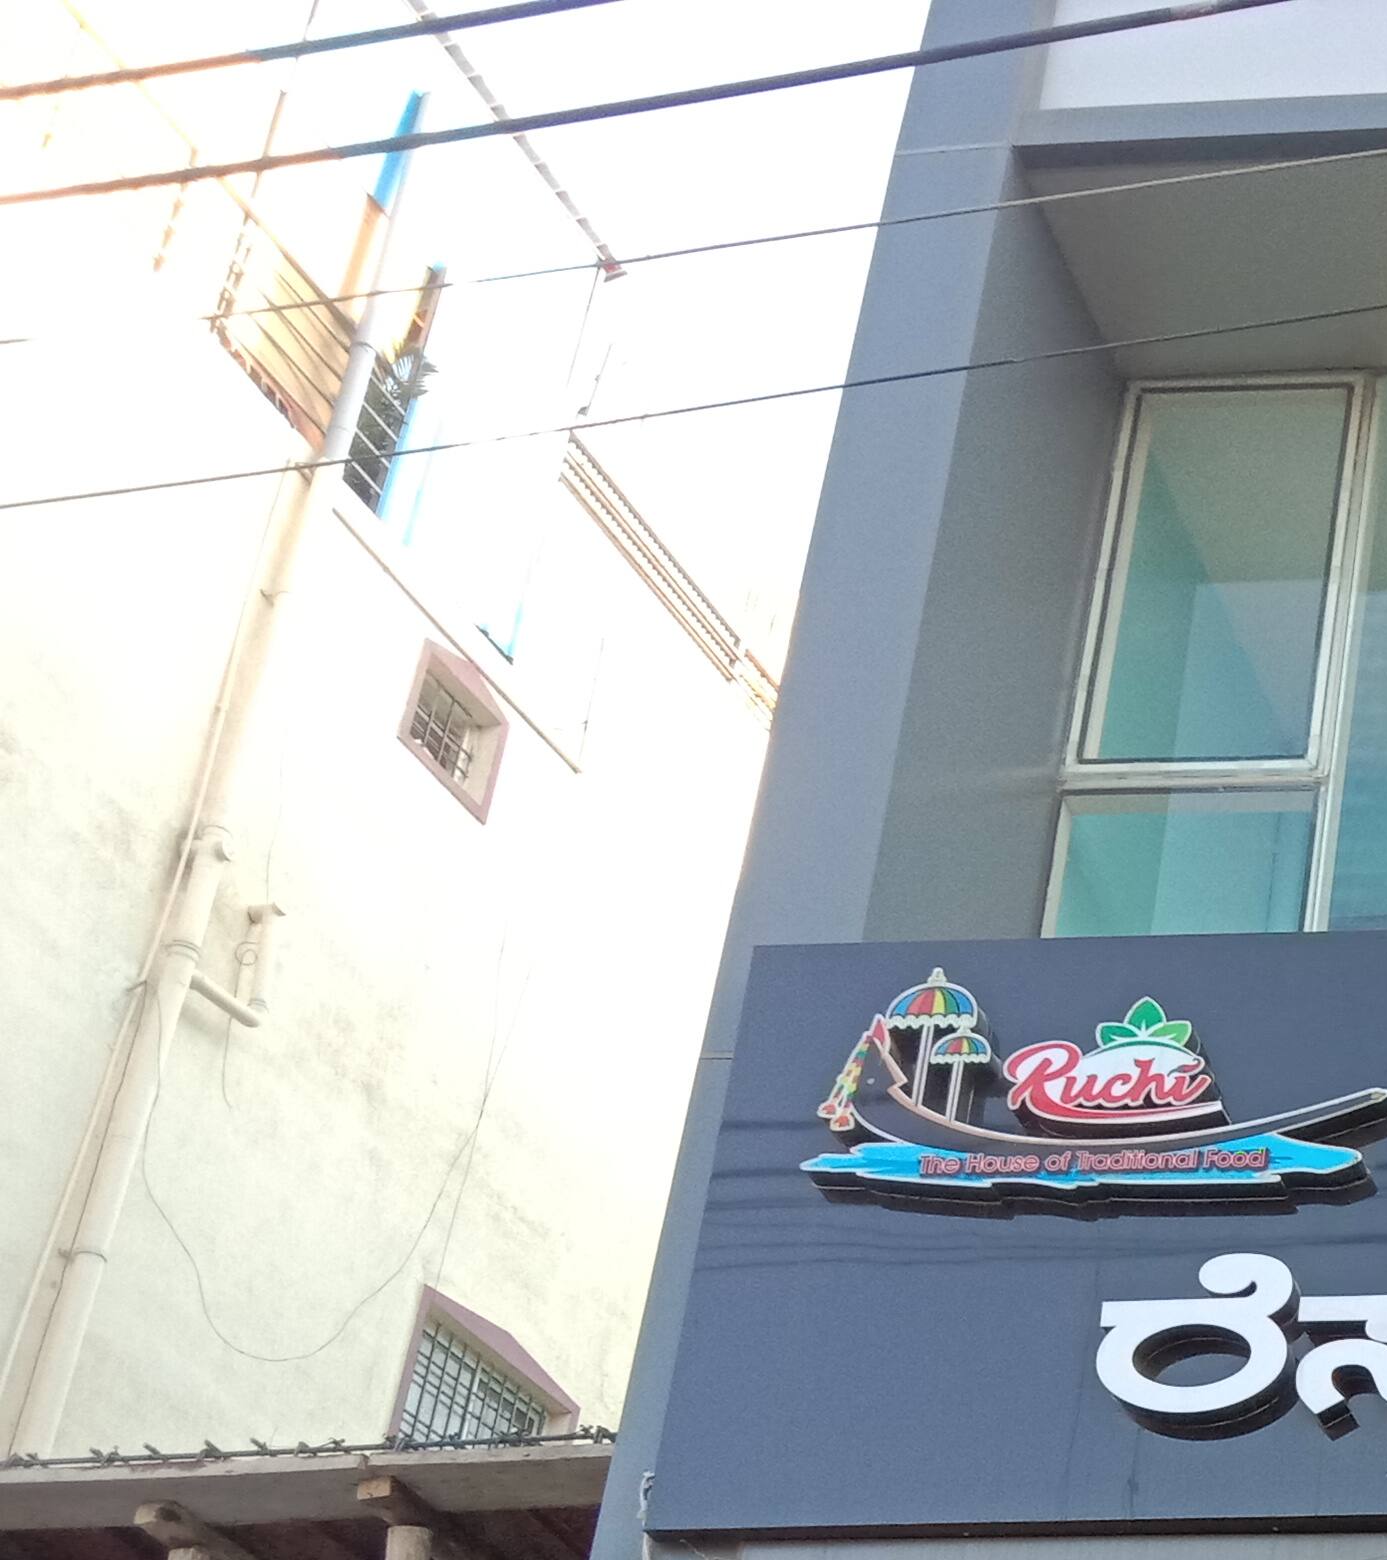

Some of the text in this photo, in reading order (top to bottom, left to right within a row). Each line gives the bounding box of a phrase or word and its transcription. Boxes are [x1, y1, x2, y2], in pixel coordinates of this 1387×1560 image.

[1008, 1042, 1221, 1120] Ruchi
[919, 1148, 1267, 1174] The House of Traditional Food
